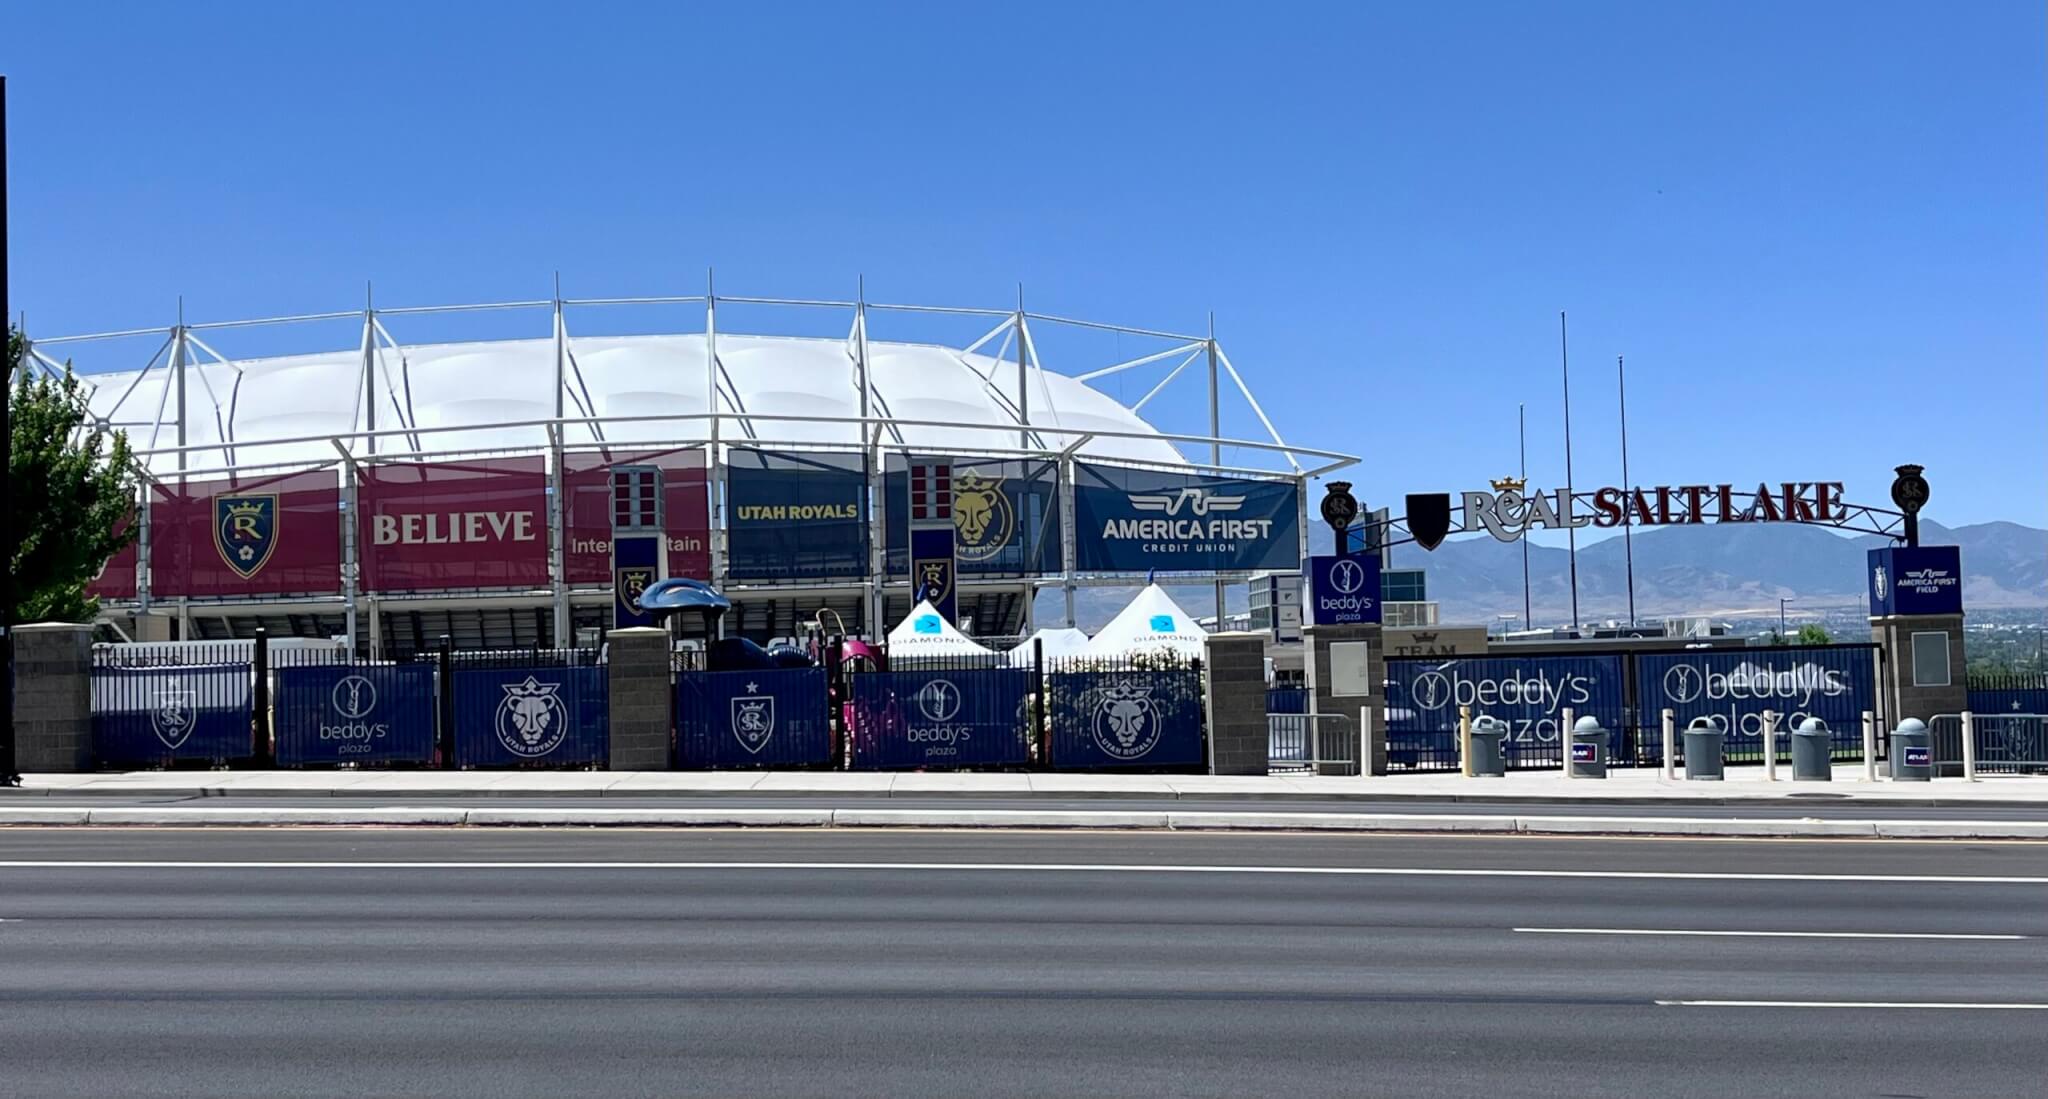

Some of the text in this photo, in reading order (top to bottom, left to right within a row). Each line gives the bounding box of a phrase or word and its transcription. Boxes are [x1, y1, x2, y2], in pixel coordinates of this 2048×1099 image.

[737, 503, 858, 520] UTAH ROYALS
[372, 510, 537, 545] BELIEVE
[1102, 518, 1273, 540] AMERICA FIRST
[1142, 543, 1236, 553] CREDIT UNION
[1320, 595, 1372, 613] beddy's
[1335, 613, 1361, 622] plaza
[892, 636, 966, 645] DIAMOND
[1133, 634, 1198, 643] DIAMOND
[1453, 668, 1590, 715] beddy's
[1706, 661, 1844, 708] beddy's
[320, 721, 386, 743] beddy's
[907, 723, 971, 746] beddy's
[338, 743, 372, 754] plaza
[925, 746, 957, 756] plaza
